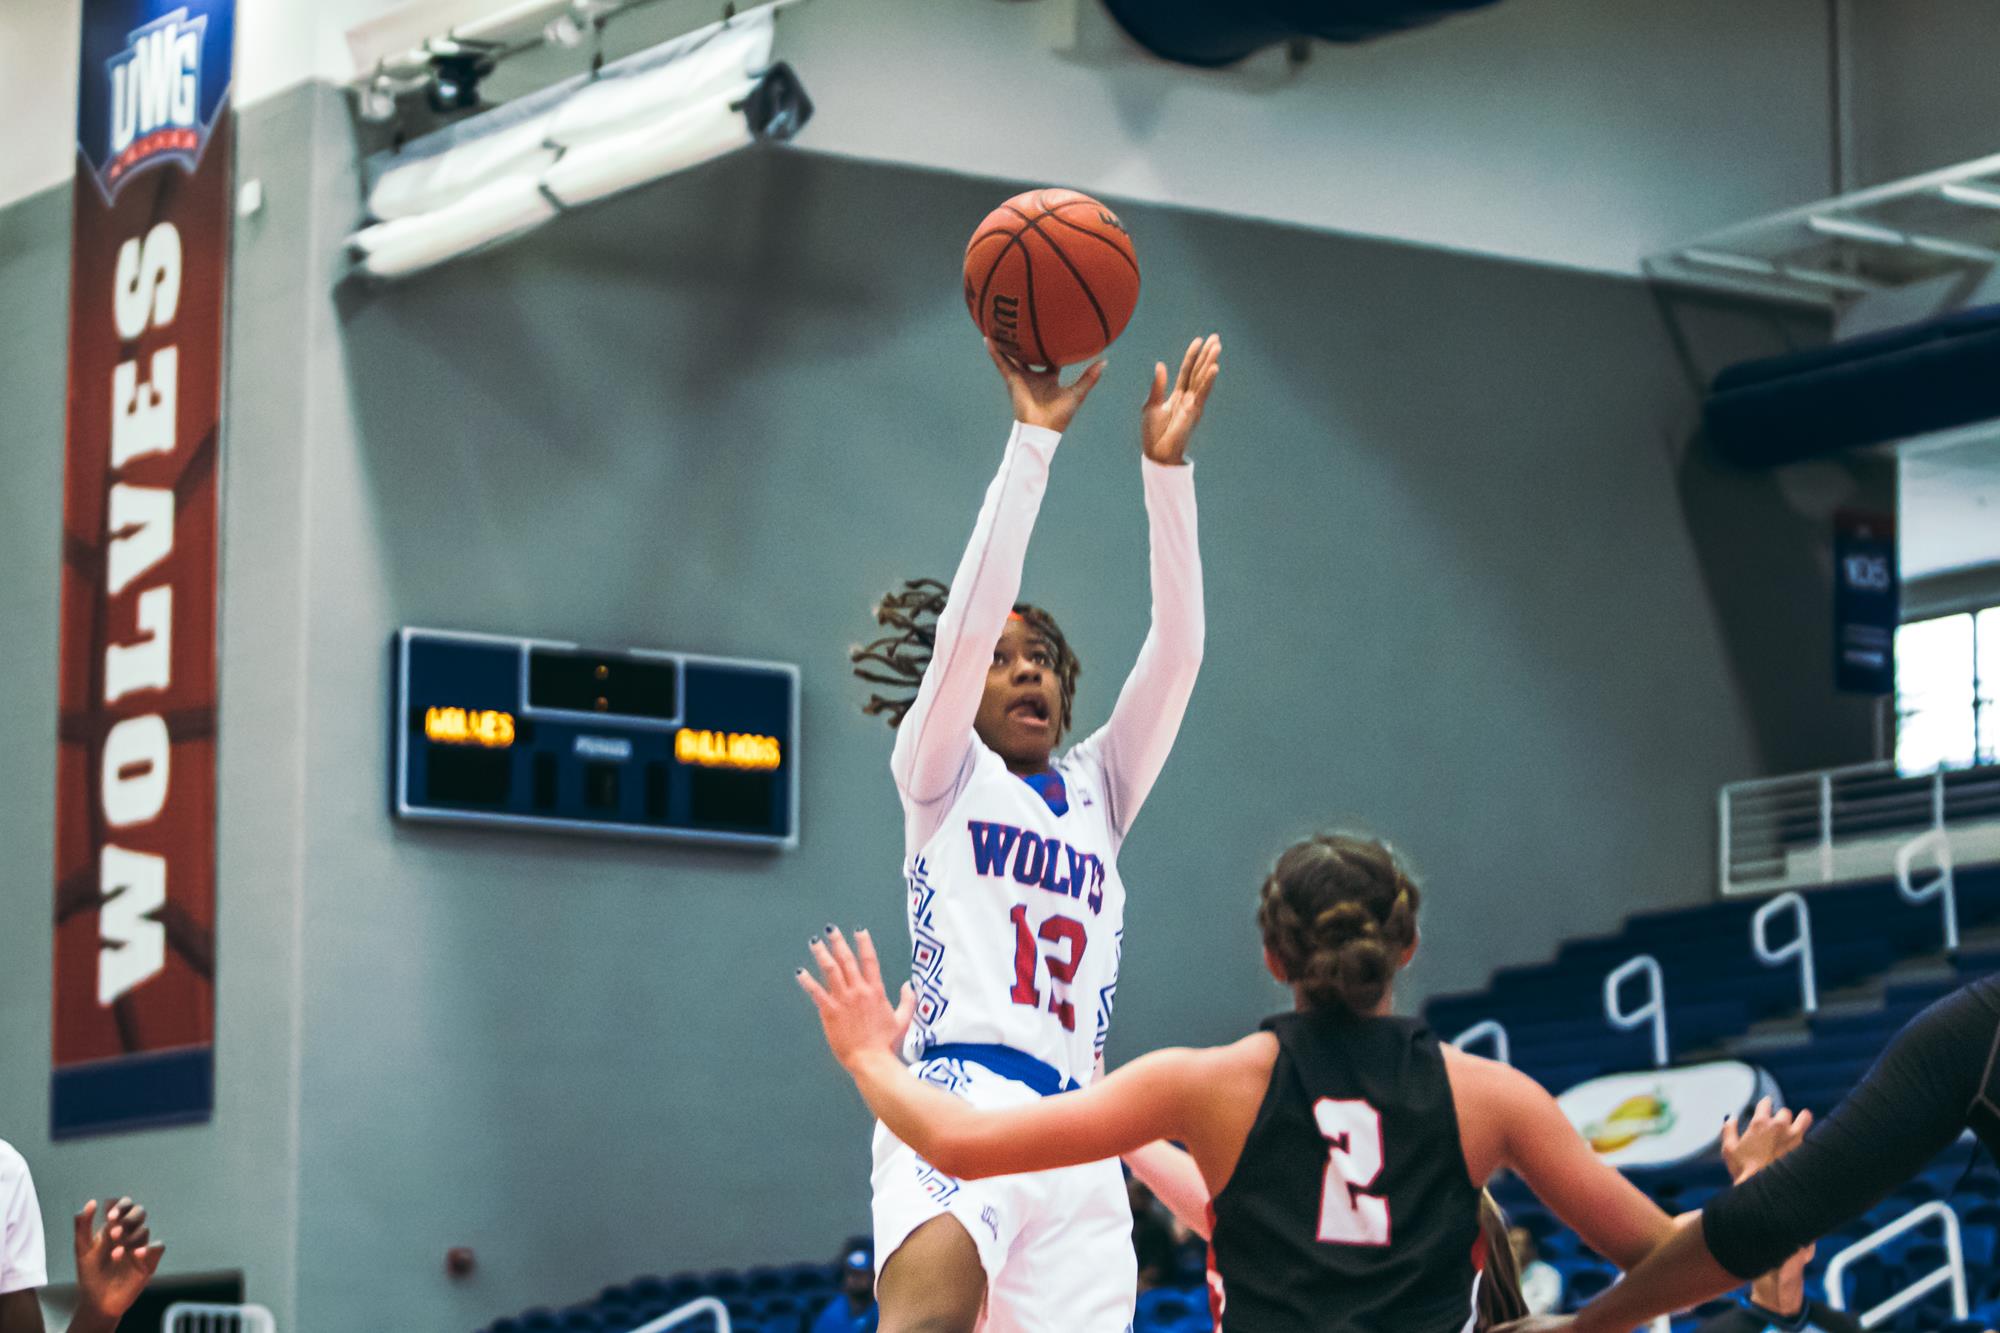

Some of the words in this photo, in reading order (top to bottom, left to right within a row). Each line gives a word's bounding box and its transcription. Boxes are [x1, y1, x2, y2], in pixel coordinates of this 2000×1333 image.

[112, 24, 197, 154] UWG
[98, 221, 181, 1007] WOLVES
[1010, 903, 1088, 1032] 12
[1312, 1096, 1391, 1246] 2
